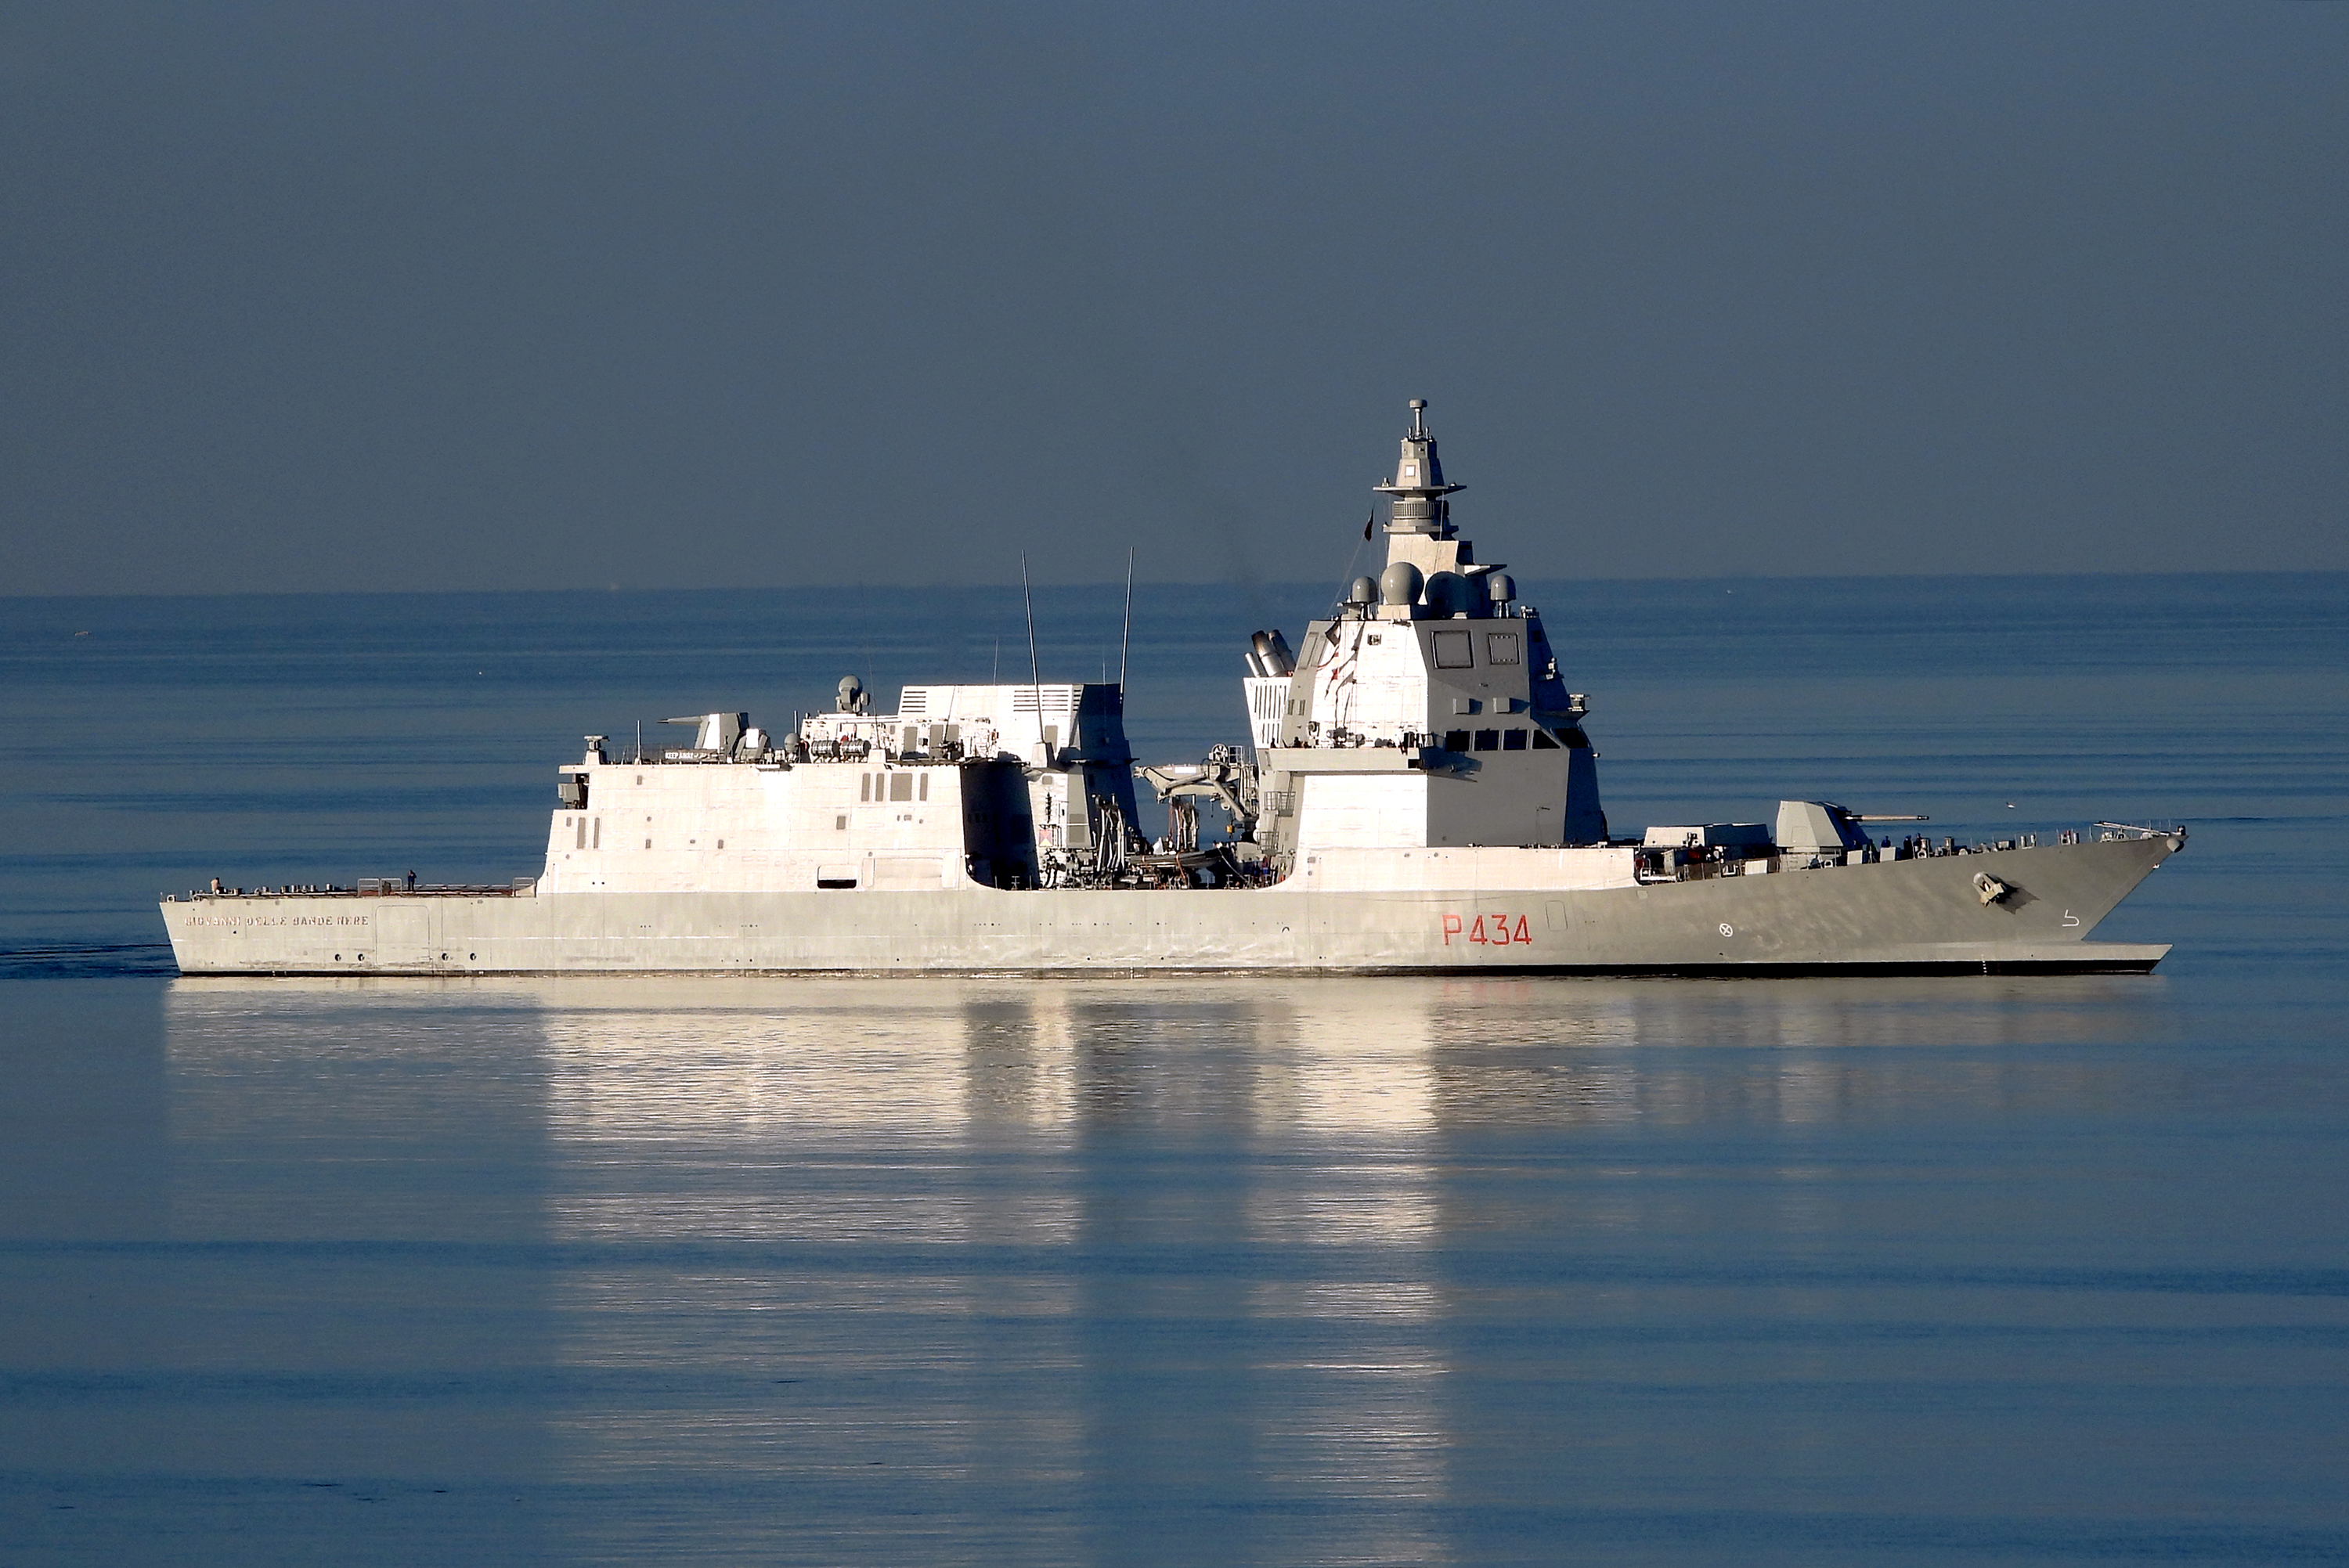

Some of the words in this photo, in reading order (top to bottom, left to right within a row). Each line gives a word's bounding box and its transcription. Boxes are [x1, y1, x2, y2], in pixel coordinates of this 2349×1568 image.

[183, 915, 240, 927] GIOVANNI
[245, 915, 287, 927] DELLE
[292, 915, 334, 927] BANDE
[337, 915, 370, 927] NERE
[1442, 914, 1532, 946] P434
